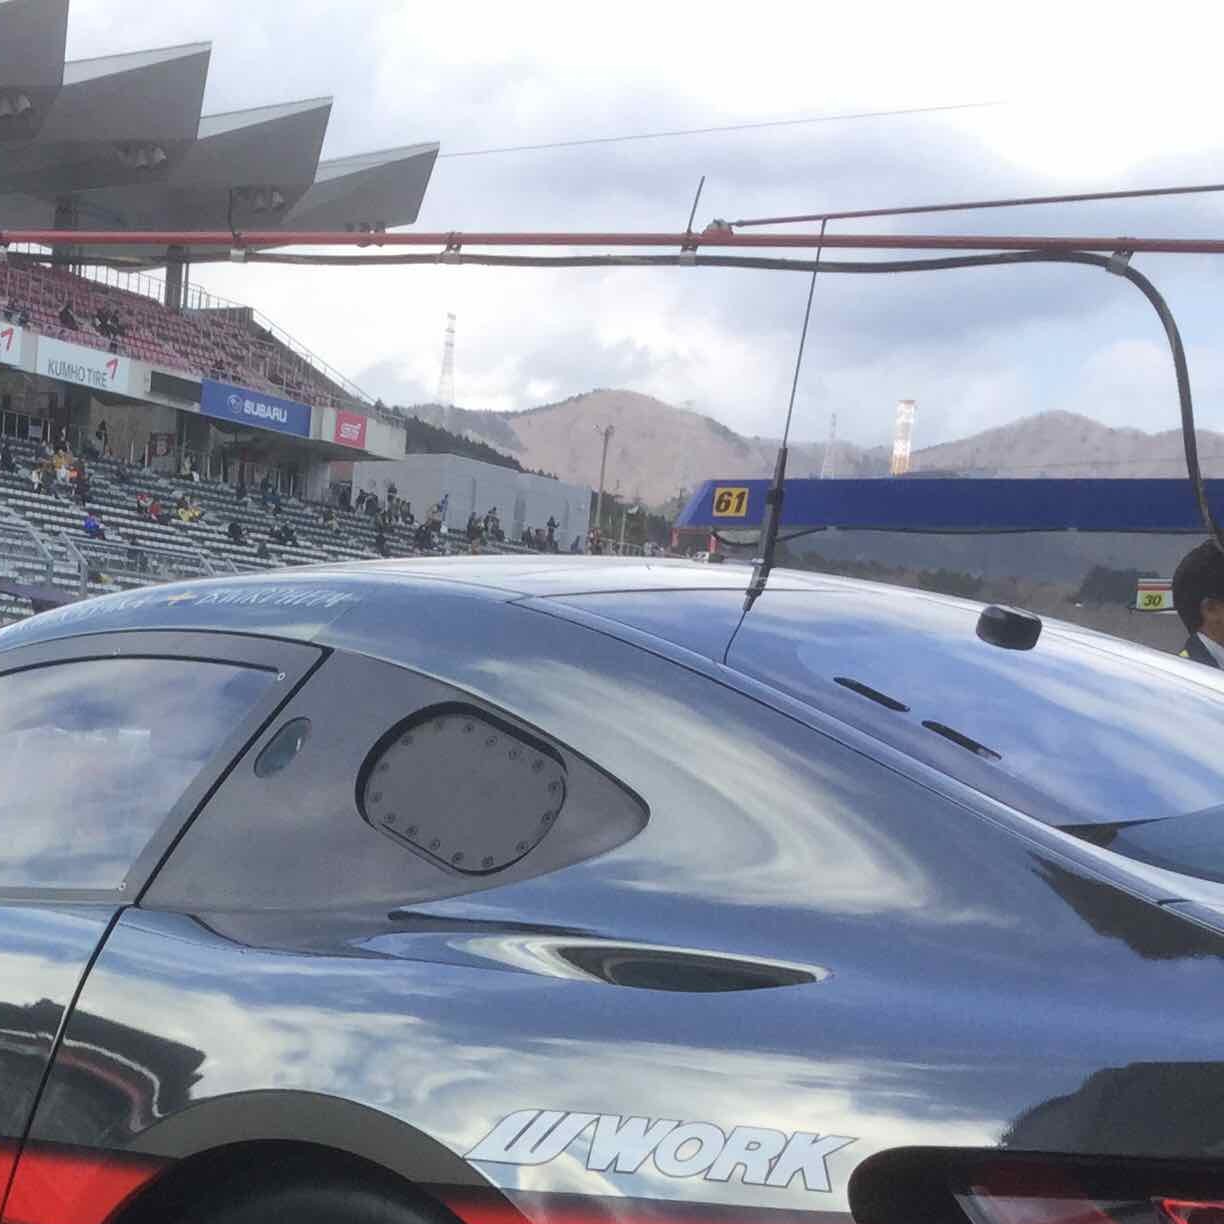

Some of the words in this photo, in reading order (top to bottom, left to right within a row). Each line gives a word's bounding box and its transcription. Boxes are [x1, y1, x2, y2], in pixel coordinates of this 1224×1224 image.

[47, 358, 86, 382] KUMHO
[87, 369, 108, 388] TIRE
[243, 400, 288, 422] SUBARU
[715, 491, 746, 513] 61
[1143, 594, 1163, 607] 30
